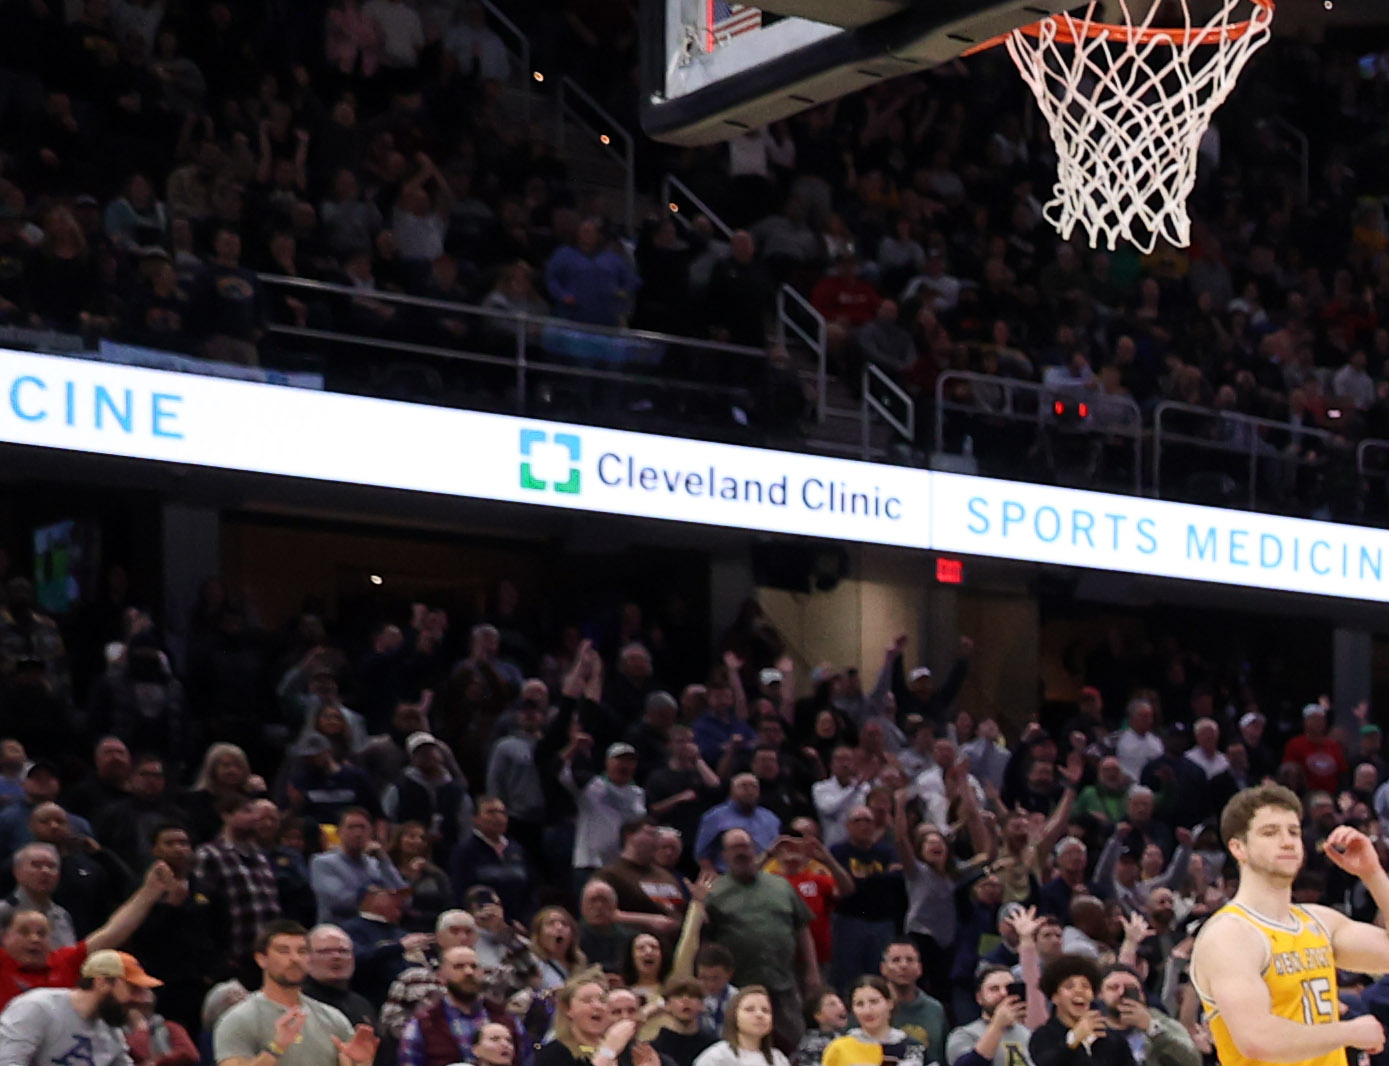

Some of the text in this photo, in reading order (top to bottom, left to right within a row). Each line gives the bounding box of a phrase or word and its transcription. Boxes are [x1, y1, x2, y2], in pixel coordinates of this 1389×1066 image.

[9, 374, 187, 440] CINE
[598, 453, 788, 507] Cleveland
[801, 477, 902, 521] Clinic
[967, 497, 1158, 554] SPORTS
[1301, 977, 1331, 1025] 15
